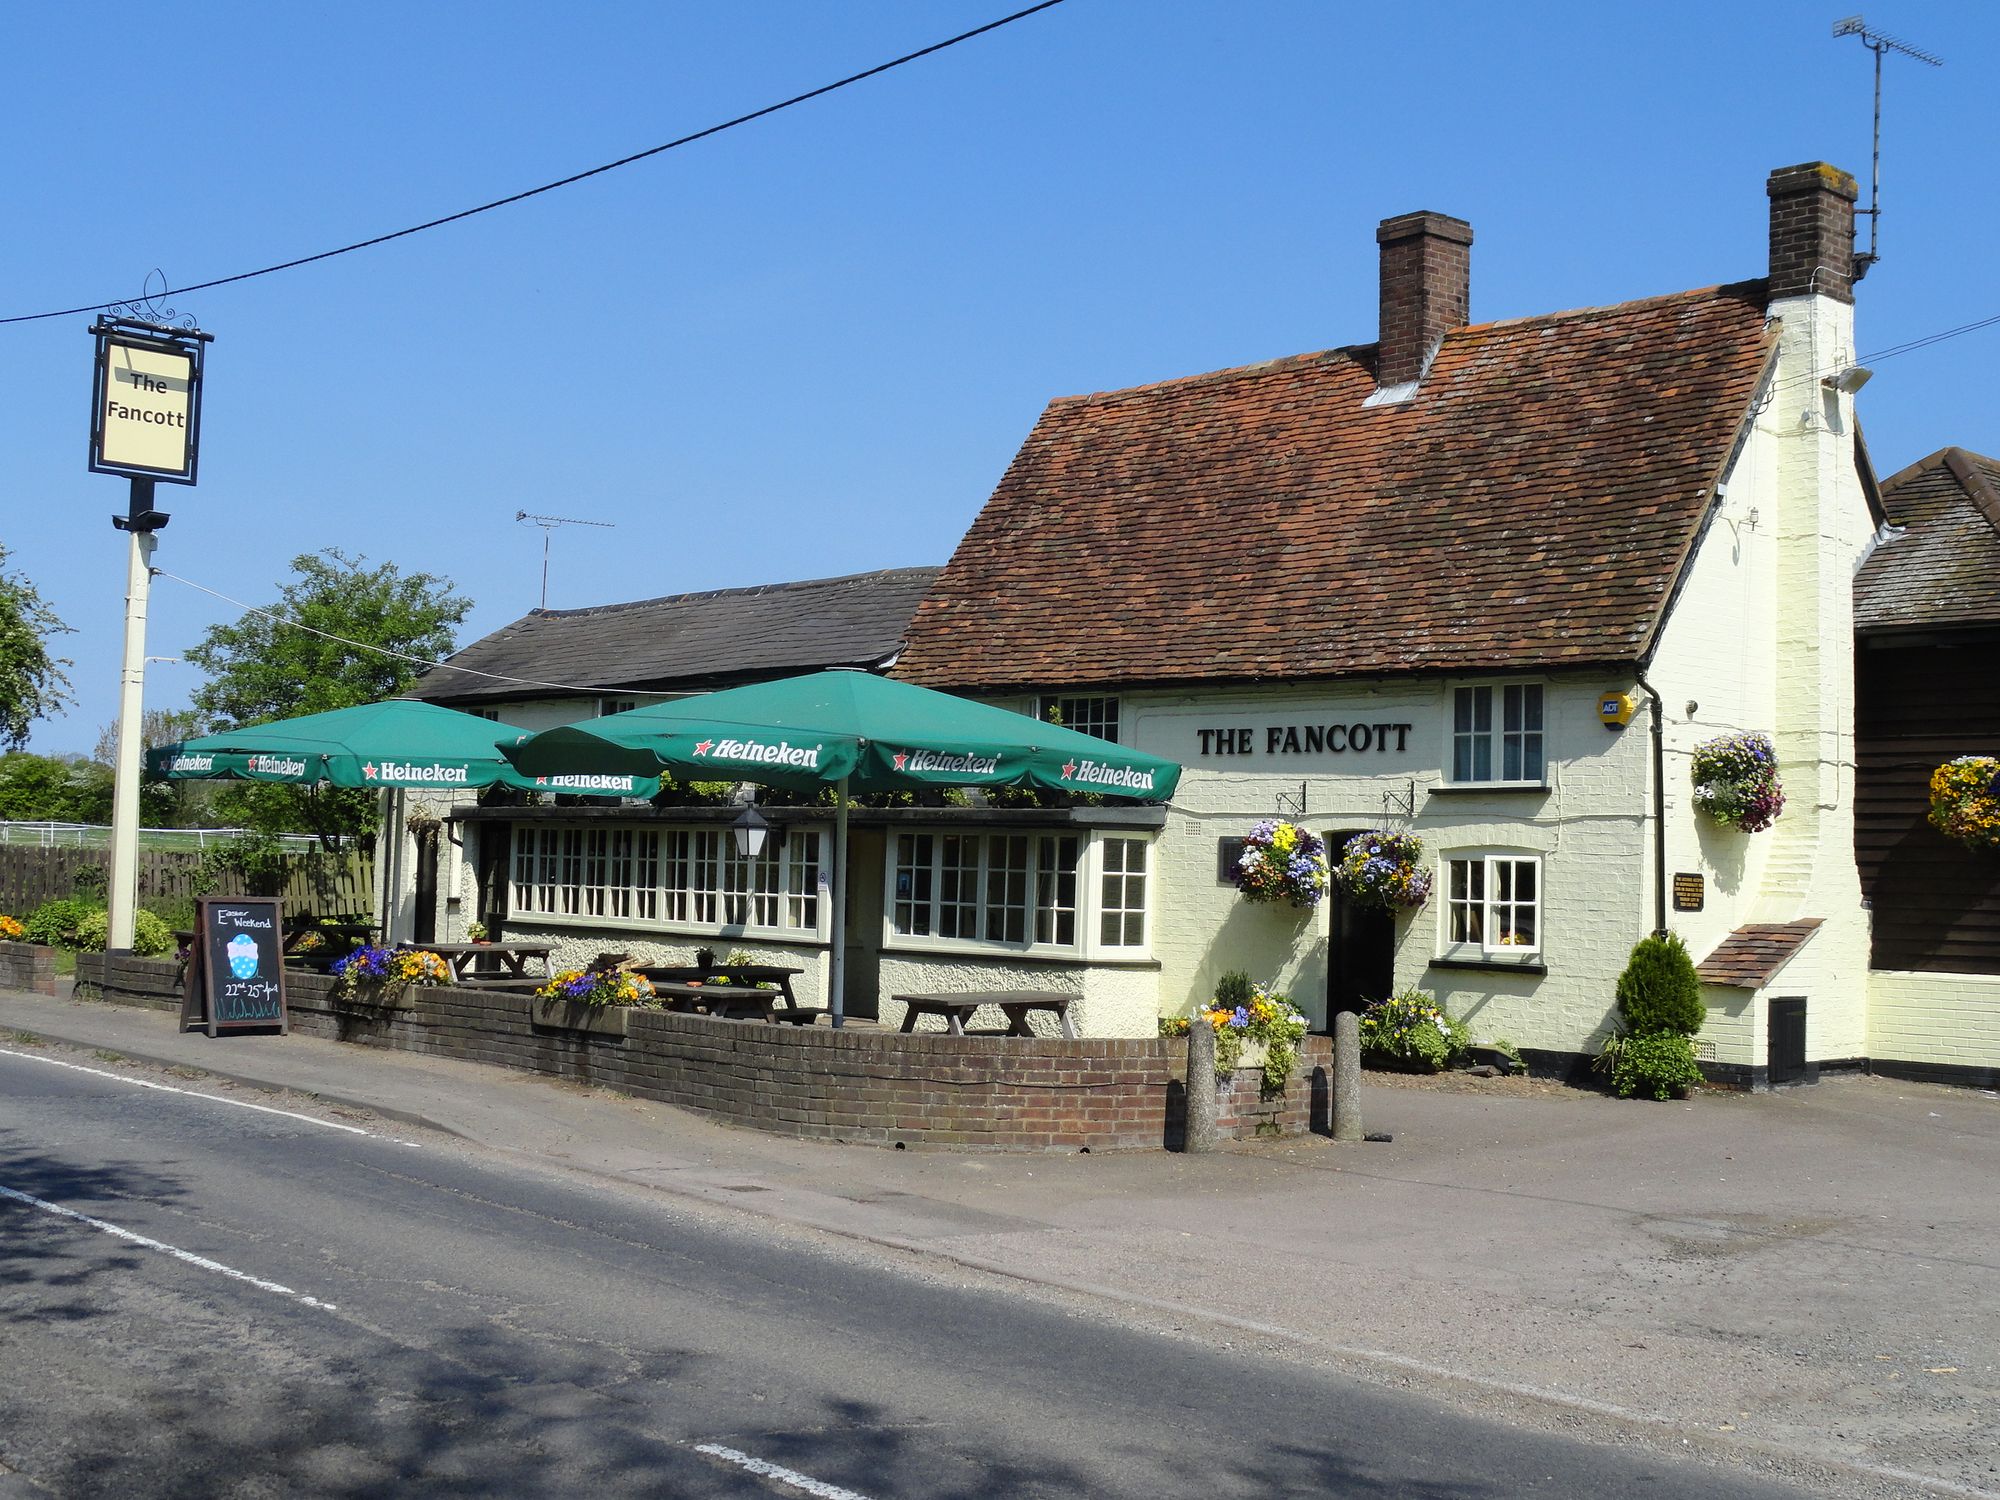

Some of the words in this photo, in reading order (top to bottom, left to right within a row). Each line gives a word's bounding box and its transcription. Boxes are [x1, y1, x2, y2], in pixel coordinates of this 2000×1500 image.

[130, 373, 168, 394] The
[107, 401, 185, 428] Fancott
[1602, 703, 1618, 712] ADT
[1197, 728, 1253, 755] THE
[1266, 723, 1412, 753] FANCOTT
[169, 754, 213, 771] Heineken
[711, 739, 818, 768] Heineken
[909, 750, 997, 774] Heineken
[257, 755, 305, 776] Heineken
[381, 762, 467, 782] Heineken
[1075, 761, 1153, 789] Heineken
[234, 917, 272, 928] Weekend
